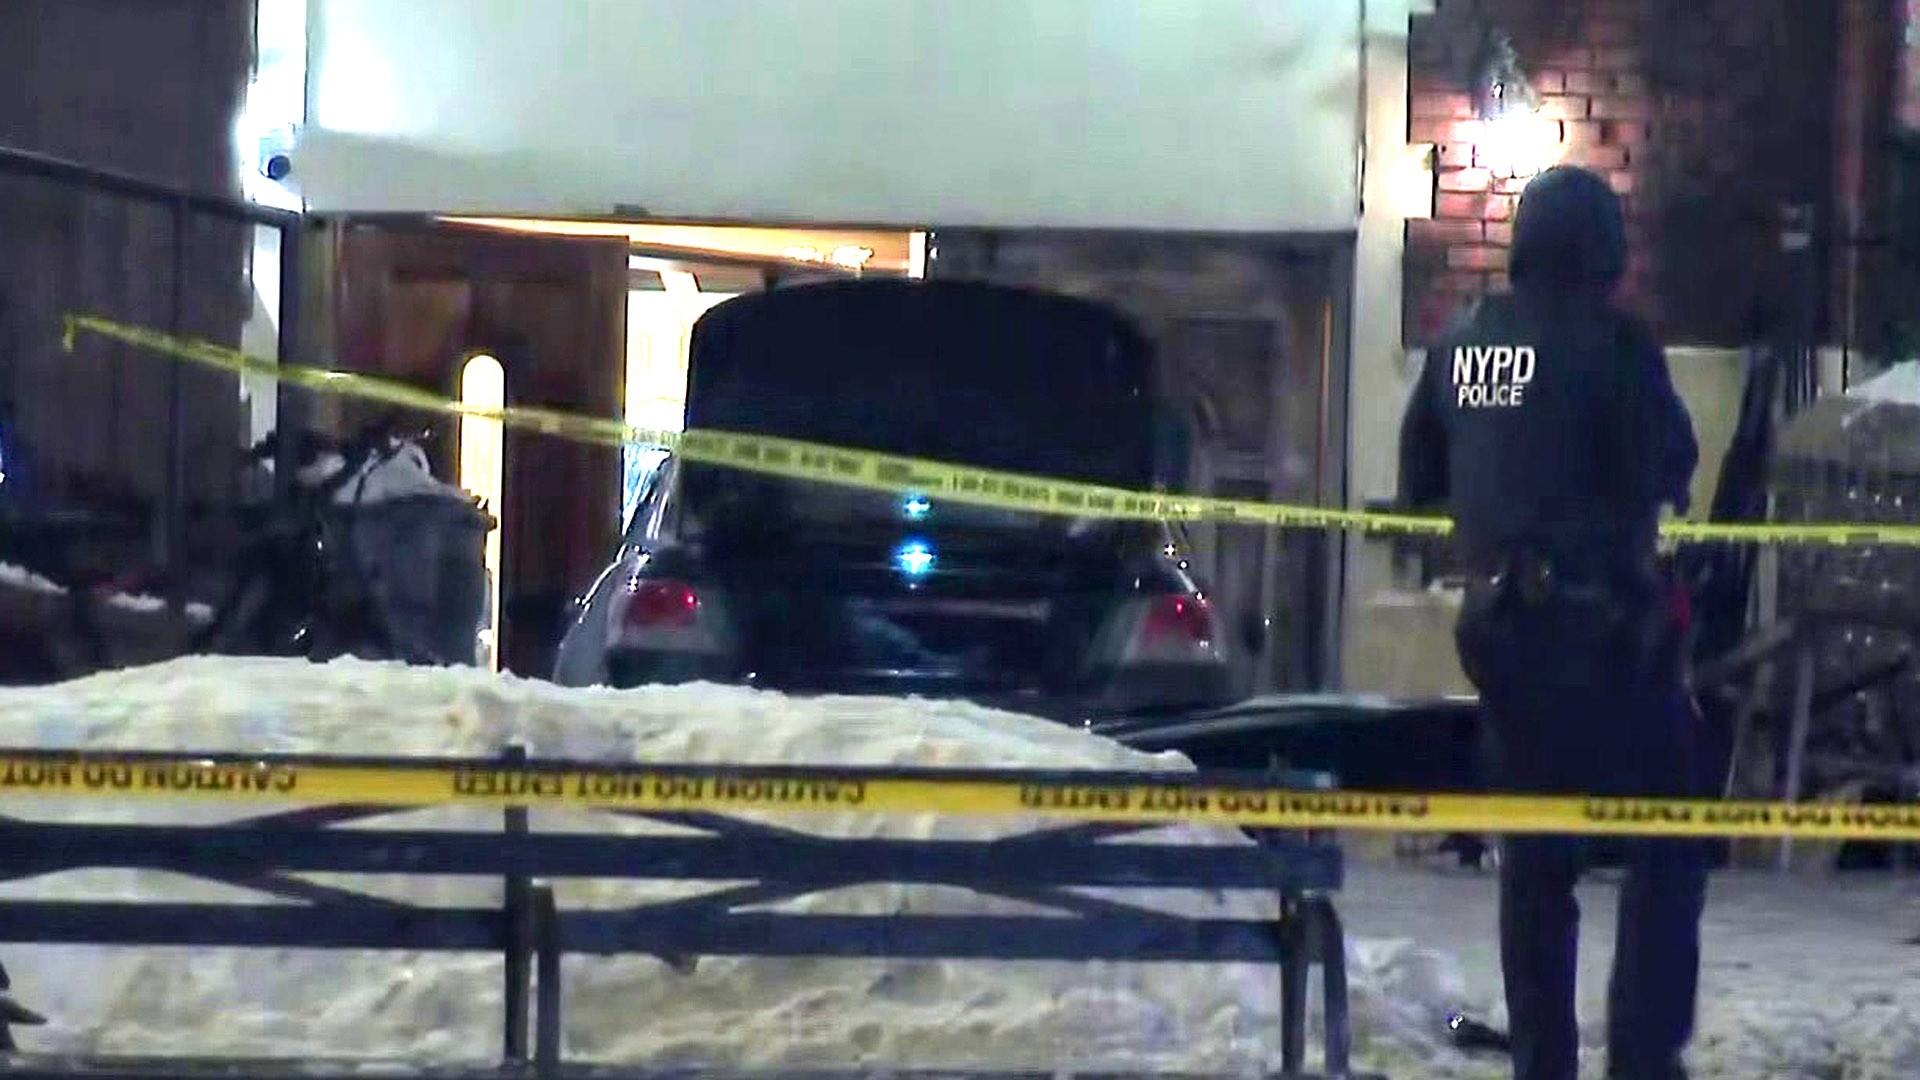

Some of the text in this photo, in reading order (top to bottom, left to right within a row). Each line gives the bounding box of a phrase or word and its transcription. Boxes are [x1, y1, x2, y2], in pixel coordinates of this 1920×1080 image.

[1453, 345, 1535, 384] NYPD
[1458, 384, 1523, 408] POLICE
[1, 760, 297, 792] CAUTION DO NOT
[452, 767, 867, 804] CAUTION DO NOT ENTER
[1019, 783, 1430, 818] CAUTION DO NOT ENTER
